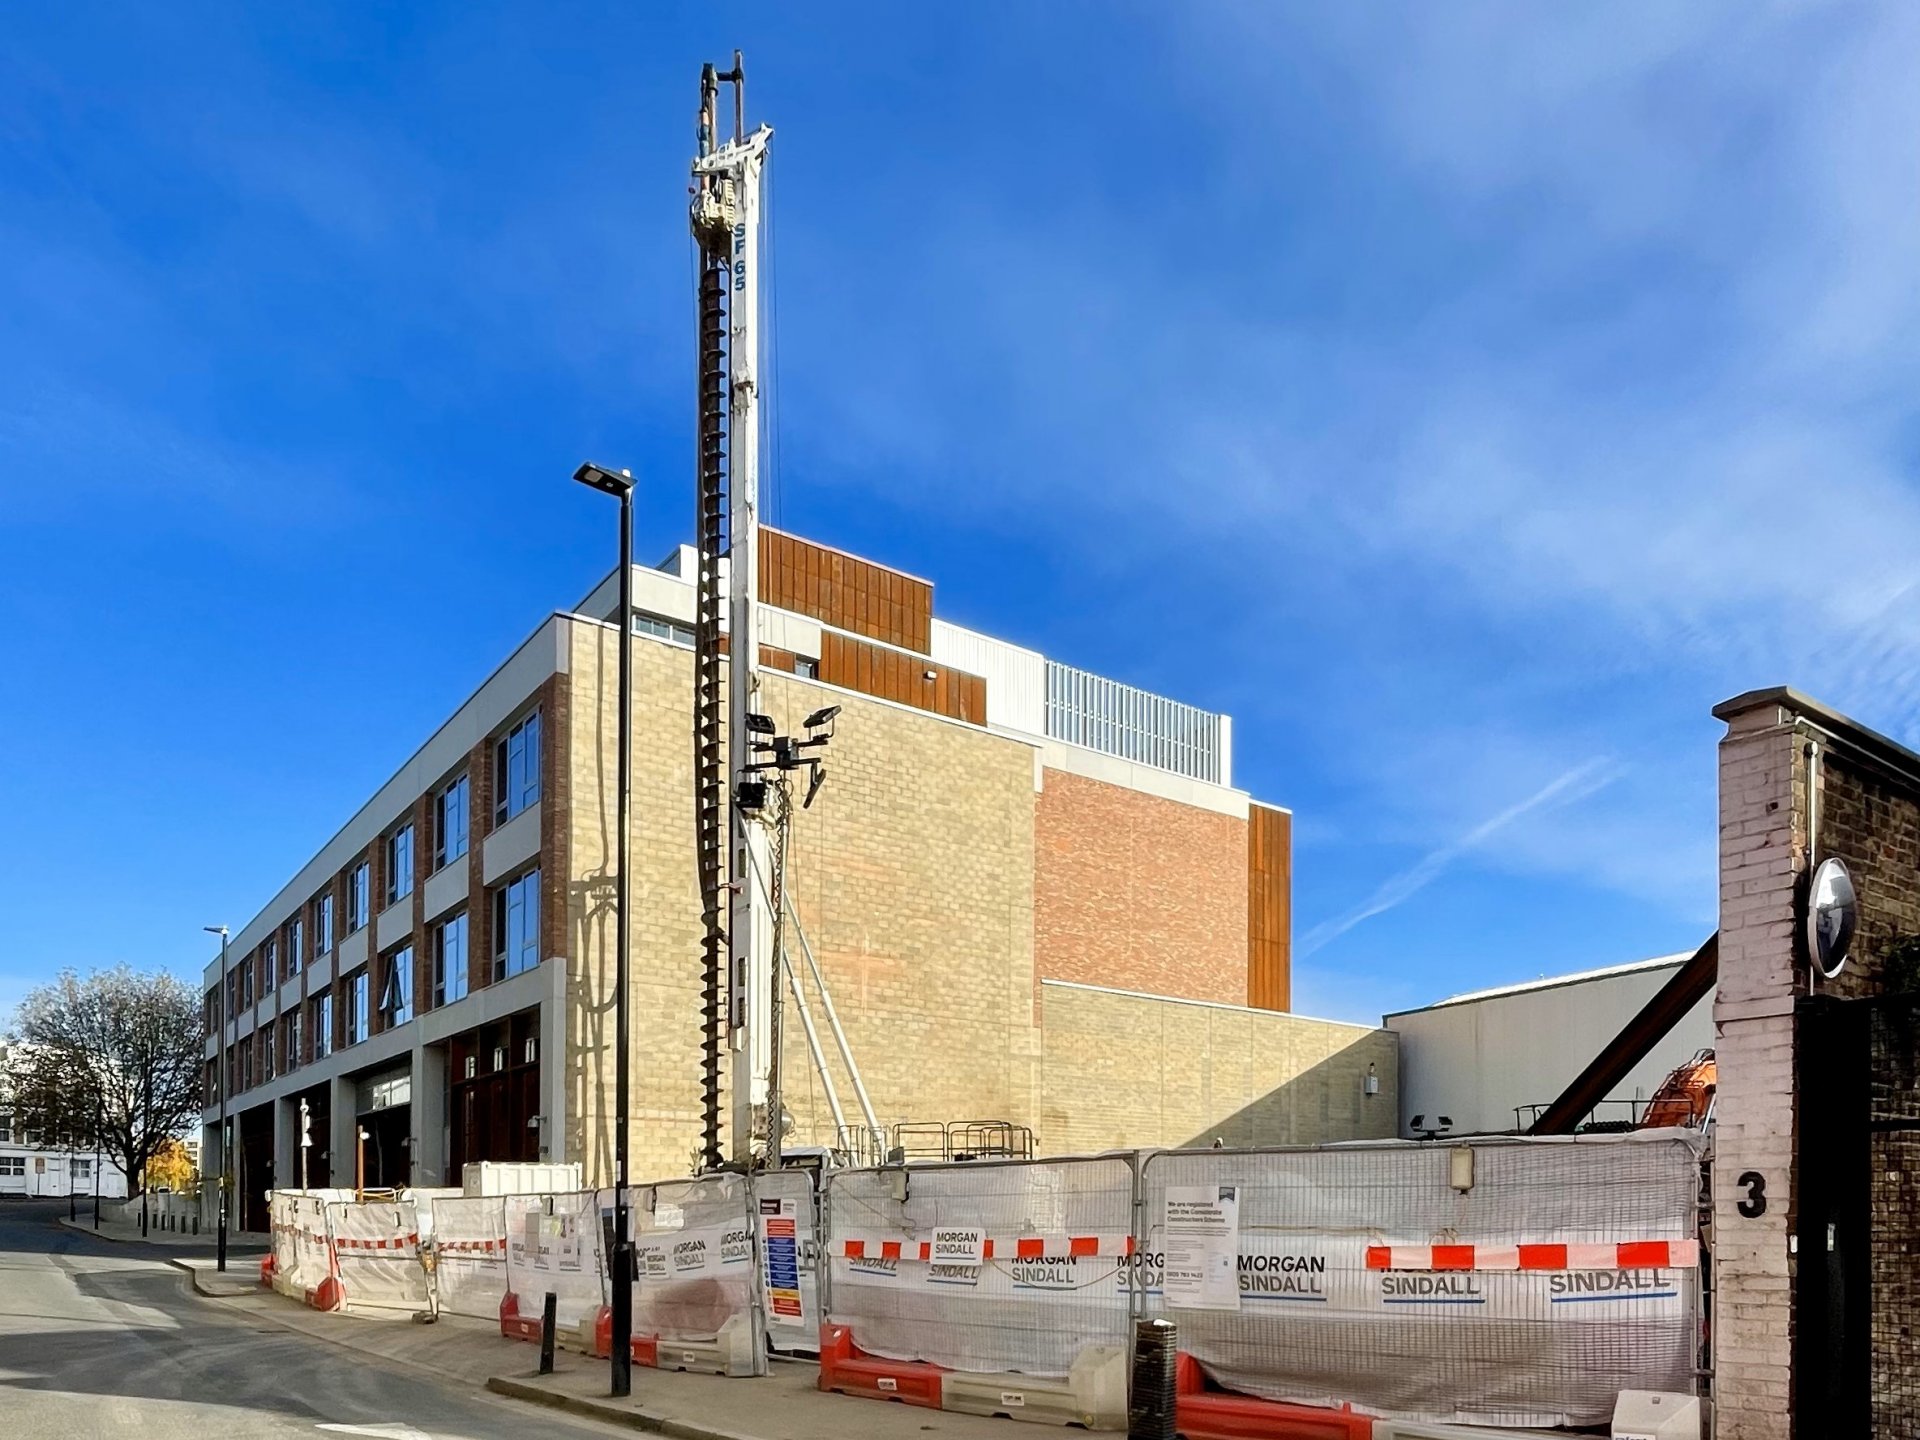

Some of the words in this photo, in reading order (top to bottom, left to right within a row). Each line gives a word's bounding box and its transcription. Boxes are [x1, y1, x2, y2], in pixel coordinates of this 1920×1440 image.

[1736, 1171, 1767, 1219] 3
[936, 1232, 978, 1243] MORGAN
[935, 1244, 975, 1255] SINDALL
[929, 1264, 979, 1280] SINDALL
[1236, 1255, 1326, 1273] MORGAN
[1012, 1267, 1075, 1284] SINDALL
[1238, 1274, 1323, 1294] SINDALL
[1549, 1268, 1671, 1294] SINDALL
[1381, 1276, 1481, 1296] SINDALL
